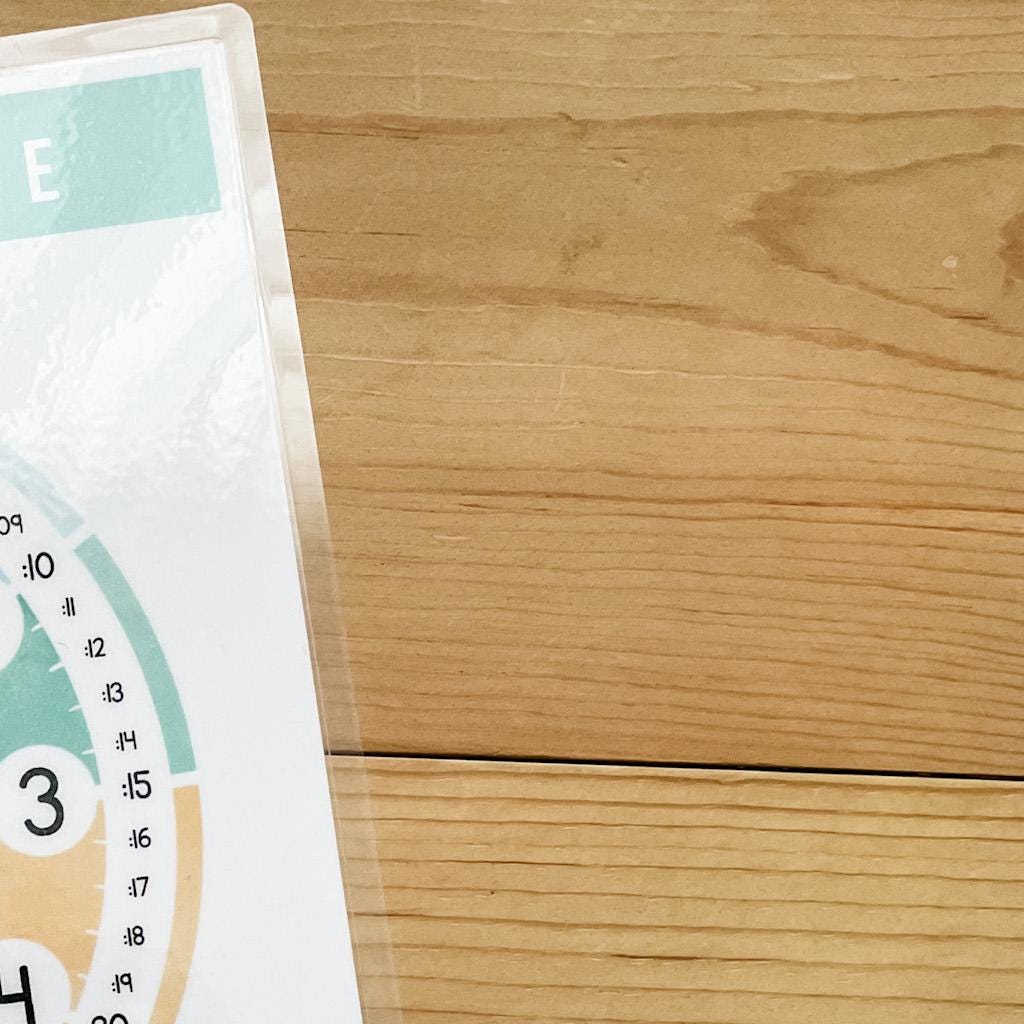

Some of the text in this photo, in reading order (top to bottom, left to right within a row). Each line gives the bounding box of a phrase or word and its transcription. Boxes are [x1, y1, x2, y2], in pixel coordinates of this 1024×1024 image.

[21, 551, 55, 581] :10
[61, 596, 76, 617] :11
[84, 637, 107, 659] :12
[101, 681, 124, 703] :13
[115, 730, 138, 752] :14
[121, 769, 152, 800] :15
[18, 766, 65, 837] 3
[128, 826, 152, 849] :16
[127, 875, 149, 898] :17
[123, 925, 145, 947] :18
[111, 972, 134, 995] :19
